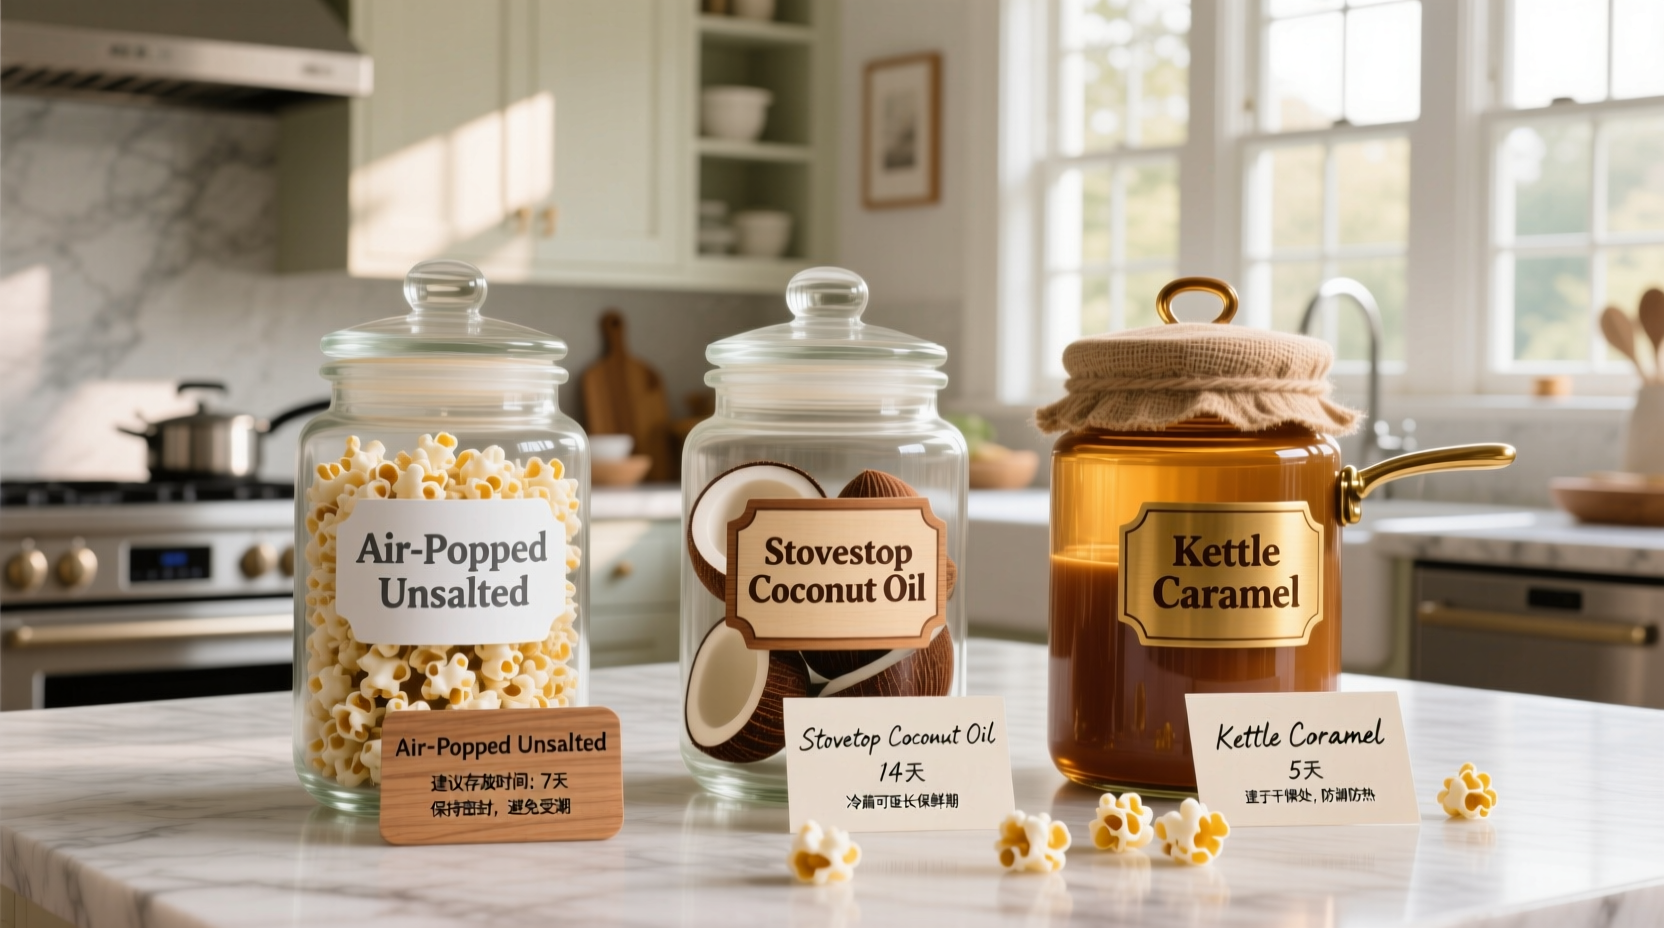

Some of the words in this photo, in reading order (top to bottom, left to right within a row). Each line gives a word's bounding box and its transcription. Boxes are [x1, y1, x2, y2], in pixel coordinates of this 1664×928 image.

[355, 530, 547, 572] Air-Popped
[764, 536, 913, 571] Stovestop
[1172, 533, 1280, 567] Kettle
[378, 574, 530, 609] Unsalted
[748, 574, 877, 603] Coconut
[883, 572, 926, 602] Oil
[1153, 574, 1300, 609] Caramel
[395, 734, 511, 760] Air-Popped
[518, 731, 607, 754] Unsalted
[799, 726, 881, 755] Stovetop
[888, 724, 962, 747] Coconut
[966, 721, 996, 745] Oil
[1216, 721, 1281, 750] Kettle
[879, 761, 926, 783] 14天
[1288, 760, 1324, 780] 5天
